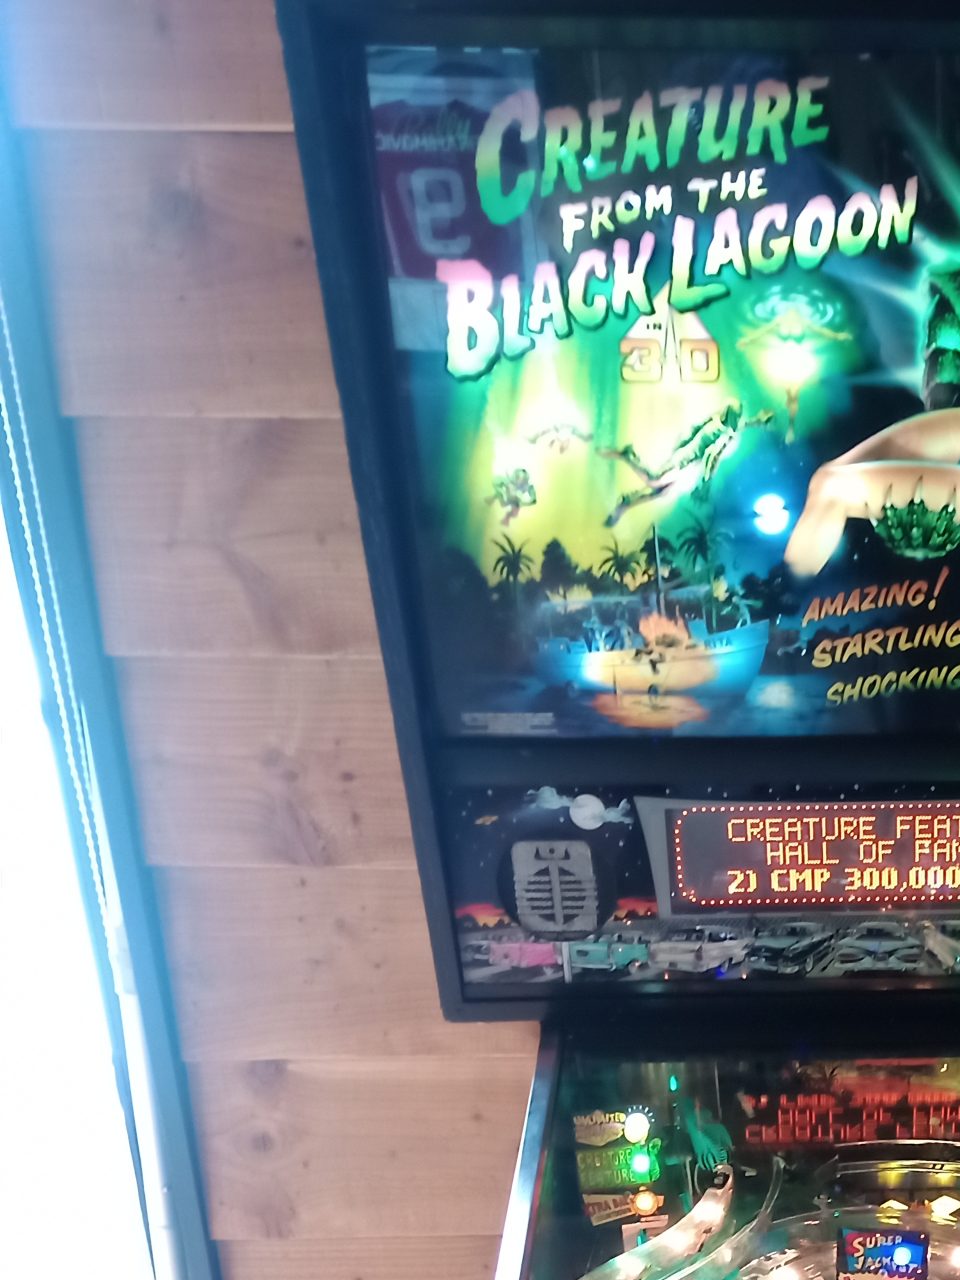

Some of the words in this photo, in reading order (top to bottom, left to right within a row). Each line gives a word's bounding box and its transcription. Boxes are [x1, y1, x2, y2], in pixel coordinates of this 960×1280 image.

[475, 76, 831, 226] CREATURE
[558, 184, 674, 253] FROM
[687, 167, 769, 214] THE
[435, 231, 656, 381] BLACK
[669, 175, 919, 313] LAGOON
[801, 566, 951, 628] AMAZING!
[727, 816, 877, 842] CREATURE
[766, 841, 840, 865] HALL
[859, 839, 895, 863] OF
[770, 866, 832, 893] CMP
[852, 1235, 903, 1257] SUPER
